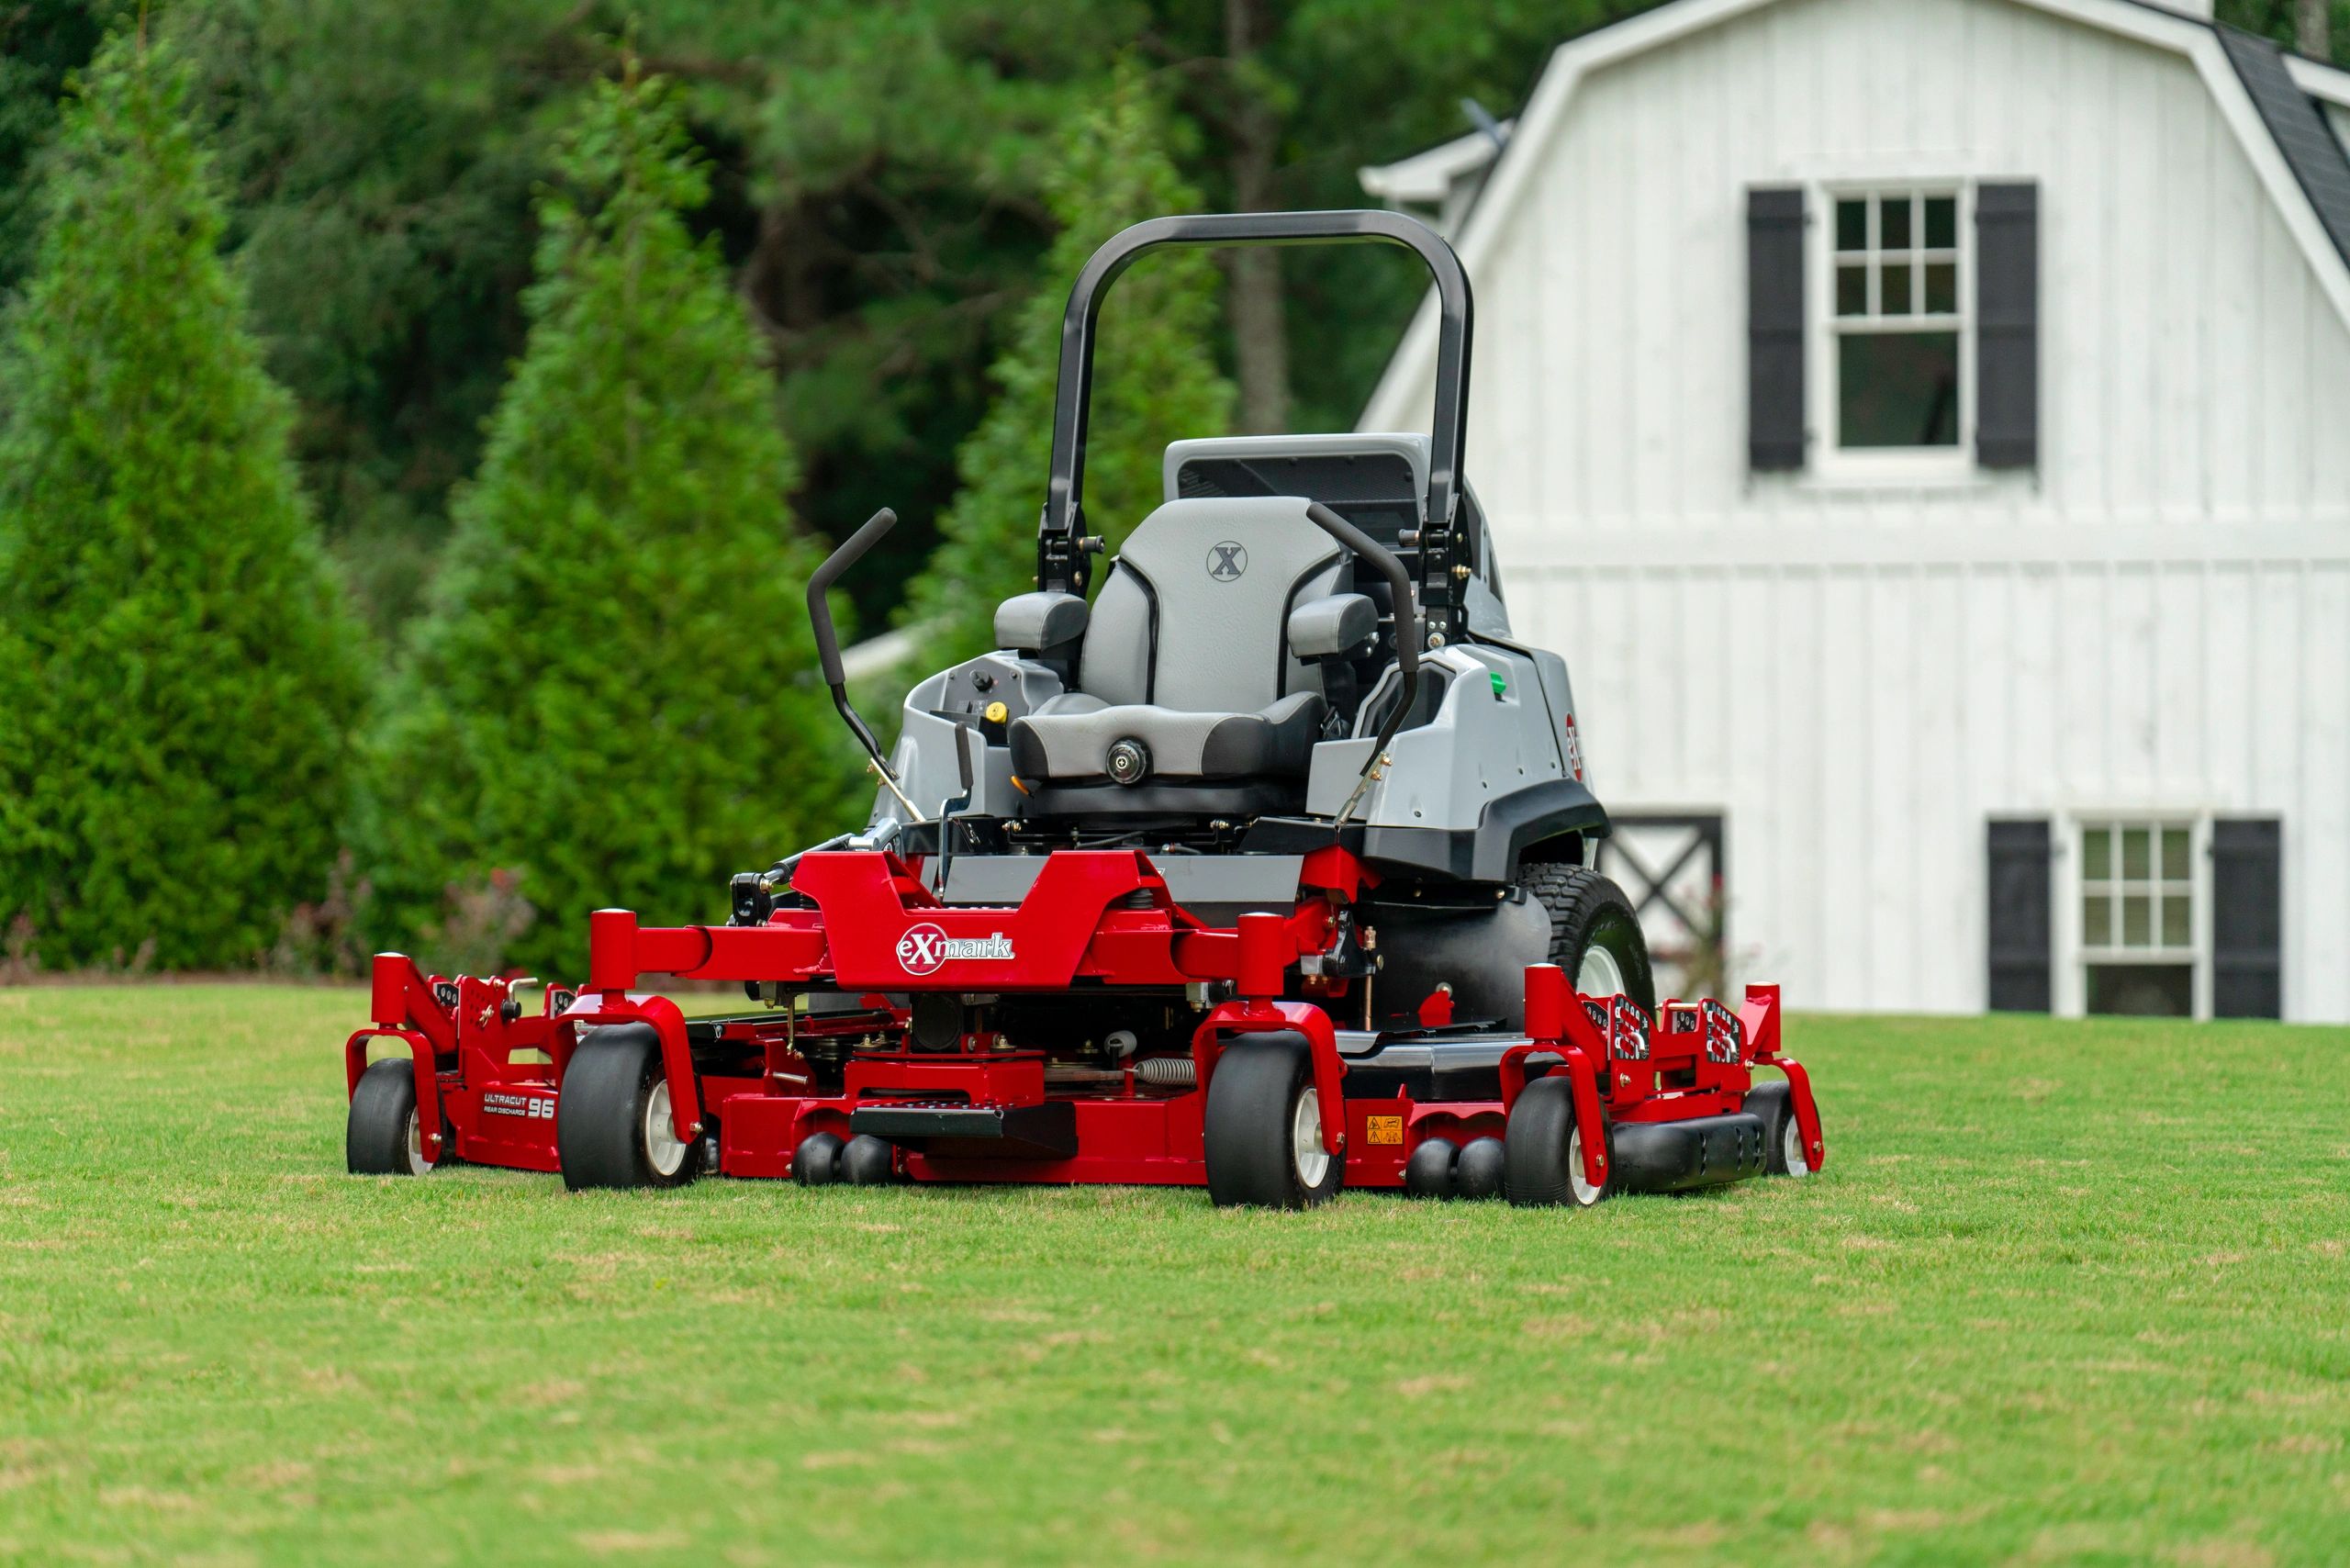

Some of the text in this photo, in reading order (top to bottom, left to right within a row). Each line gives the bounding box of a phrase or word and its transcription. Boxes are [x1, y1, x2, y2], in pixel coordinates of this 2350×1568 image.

[1213, 546, 1242, 575] X
[484, 1093, 527, 1106] ULTRACUT
[483, 1105, 526, 1117] REAR DISCHARGE
[528, 1098, 555, 1119] 96
